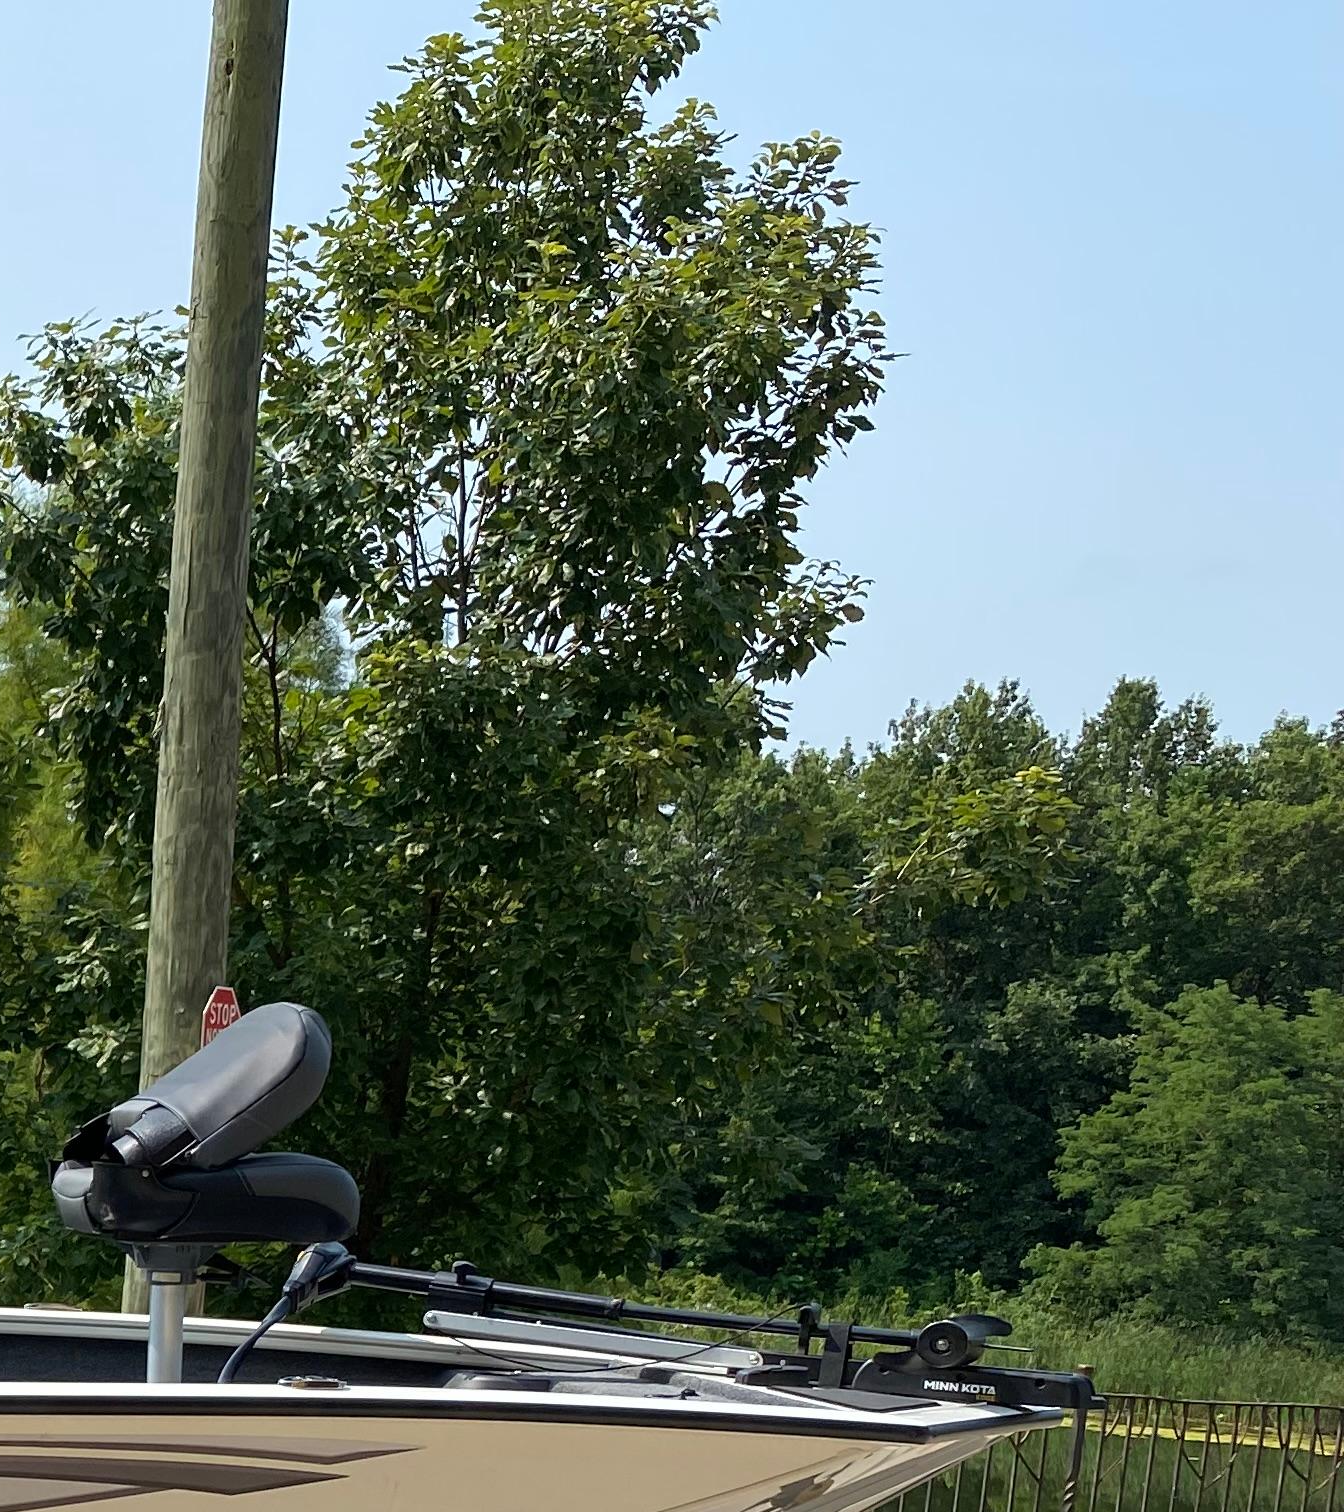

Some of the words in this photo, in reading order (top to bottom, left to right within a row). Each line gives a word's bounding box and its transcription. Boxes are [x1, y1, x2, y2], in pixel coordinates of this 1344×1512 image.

[210, 1002, 237, 1025] STOP
[923, 1380, 959, 1392] MINN
[961, 1384, 996, 1394] KOTA
